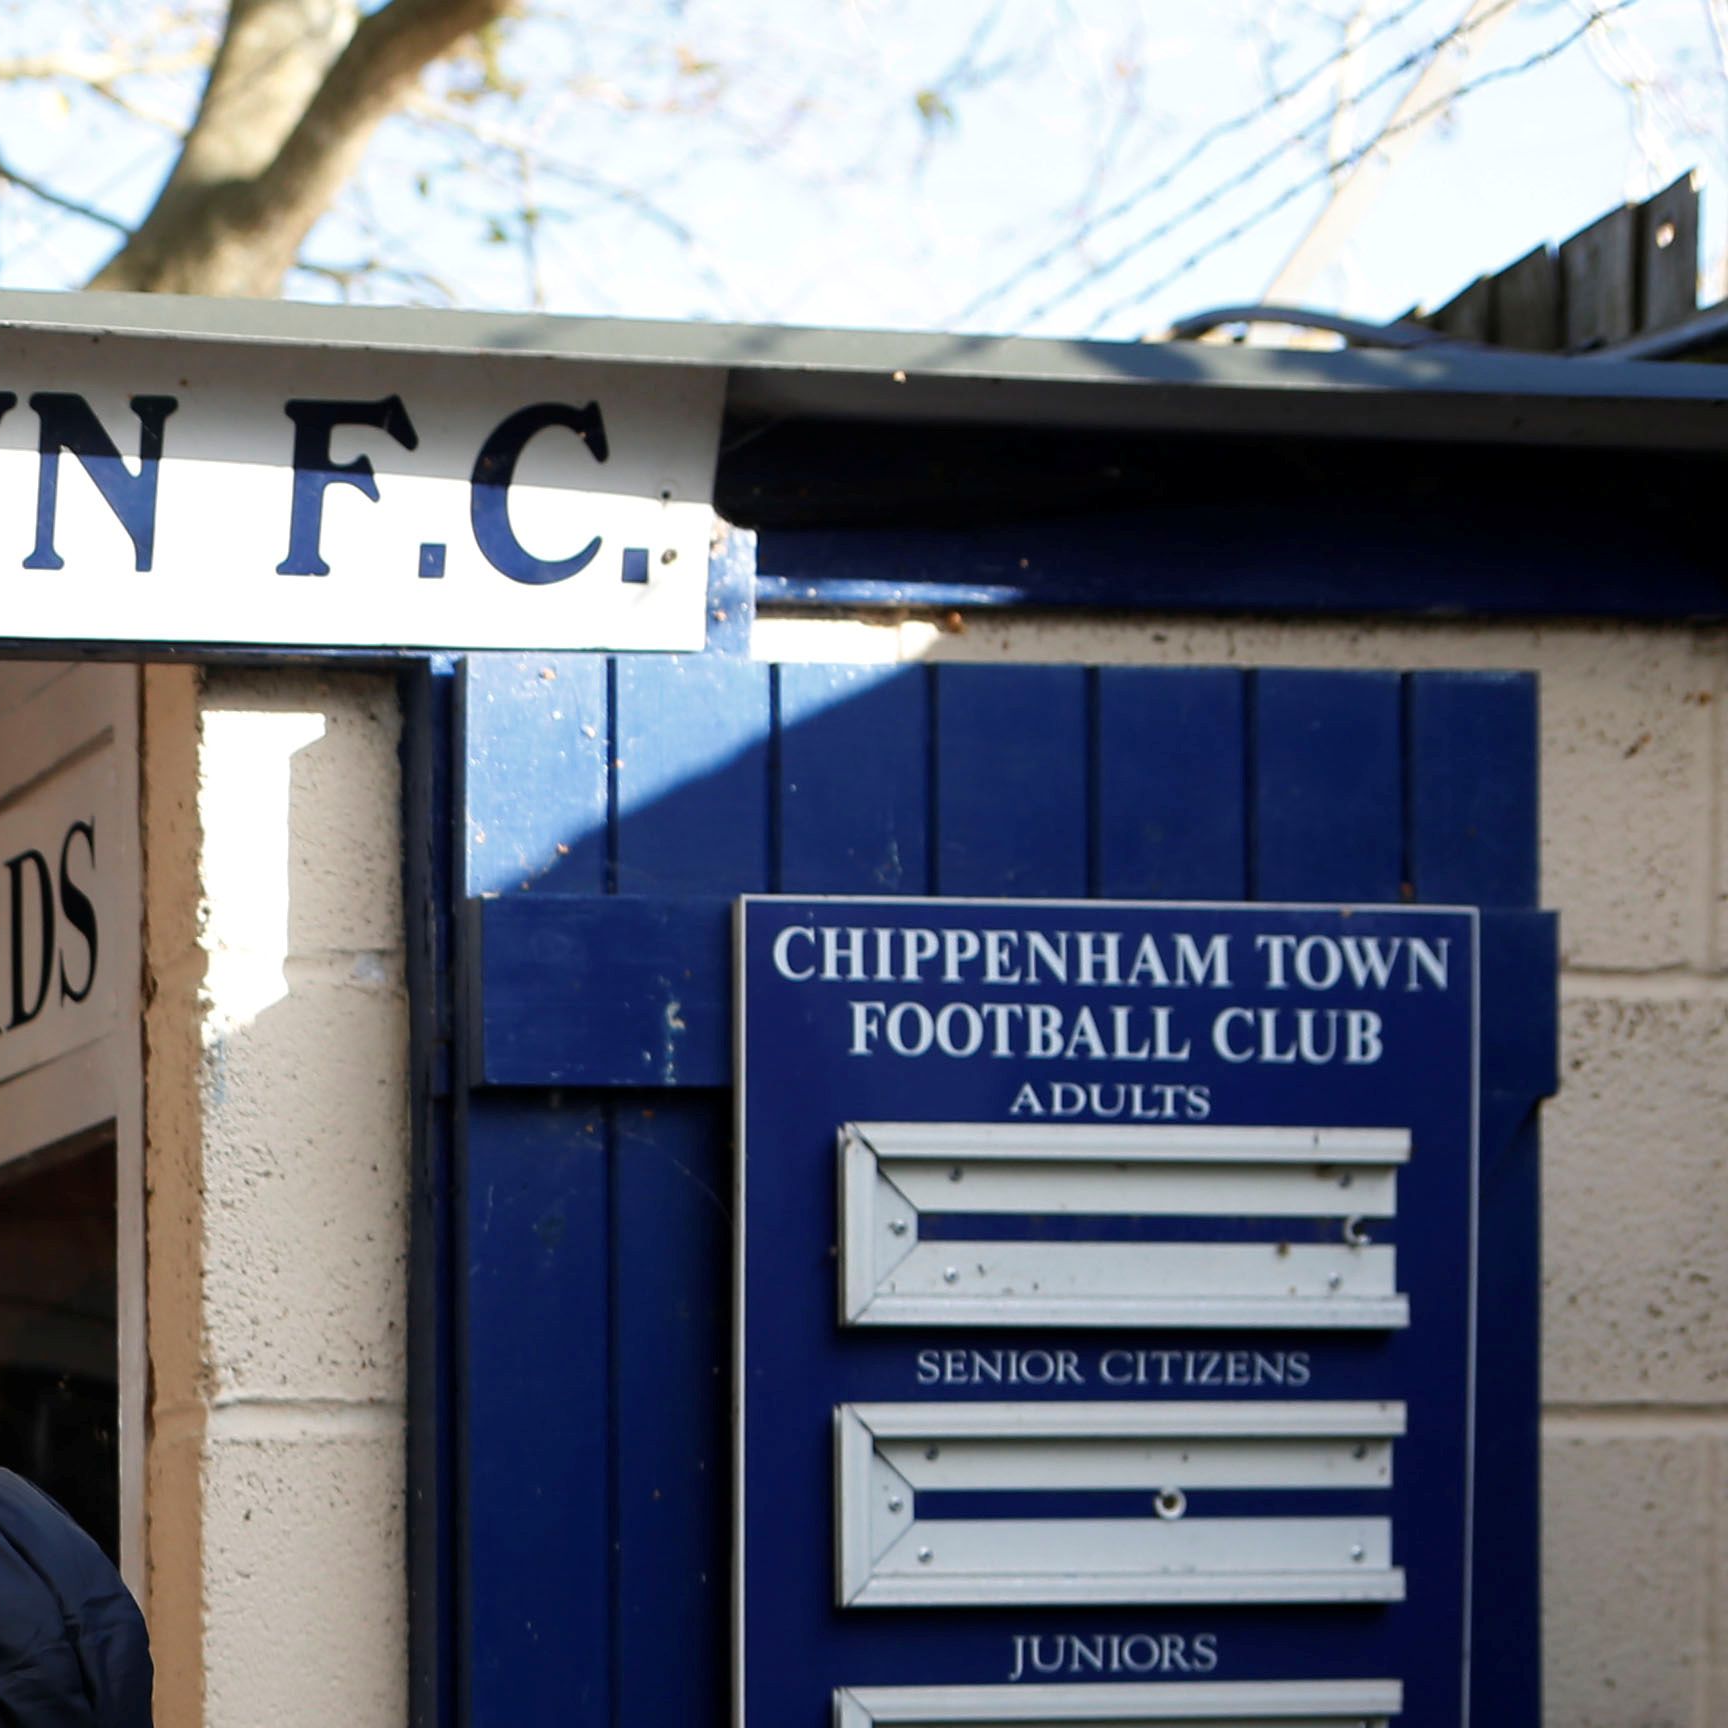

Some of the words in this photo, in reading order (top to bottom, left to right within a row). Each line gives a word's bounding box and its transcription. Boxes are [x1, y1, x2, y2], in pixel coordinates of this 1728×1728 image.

[277, 394, 650, 585] F.C.
[773, 926, 1230, 986] CHIPPENHAM
[1256, 935, 1450, 990] TOWN
[850, 1002, 1190, 1060] FOOTBALL
[1213, 1008, 1383, 1063] CLUB
[1010, 1083, 1211, 1118] ADULTS
[917, 1350, 1084, 1383] SENIOR
[1099, 1351, 1311, 1385] CITIZENS
[1010, 1635, 1219, 1680] JUNIORS
